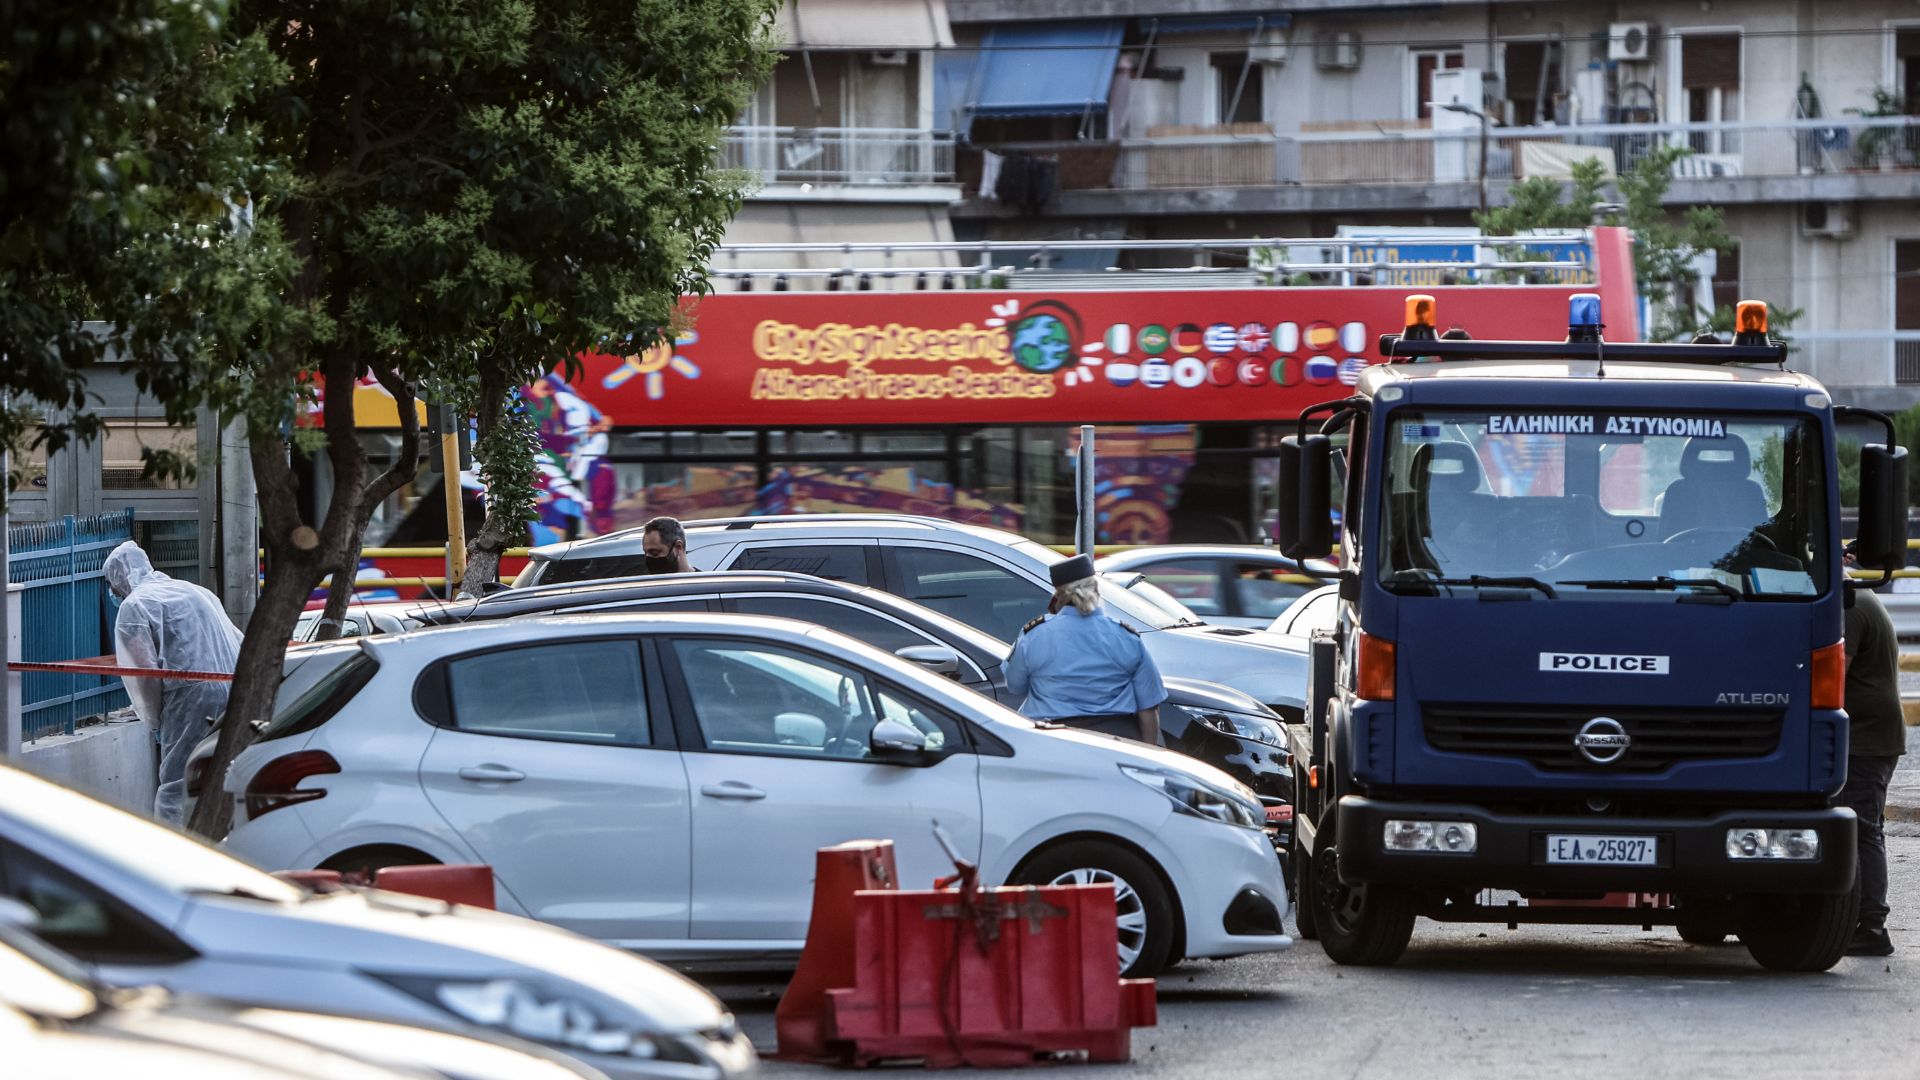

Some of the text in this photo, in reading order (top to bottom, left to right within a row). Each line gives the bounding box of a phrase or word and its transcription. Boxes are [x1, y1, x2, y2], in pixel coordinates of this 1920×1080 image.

[1489, 416, 1725, 437] ΕΛΛΗΝΙΚΗ ΑΣΤΥΝΟΜΙΑ
[1552, 655, 1657, 671] POLICE
[1715, 692, 1790, 704] ATLEON
[1581, 736, 1625, 745] NISSAN
[1597, 839, 1647, 861] 25927
